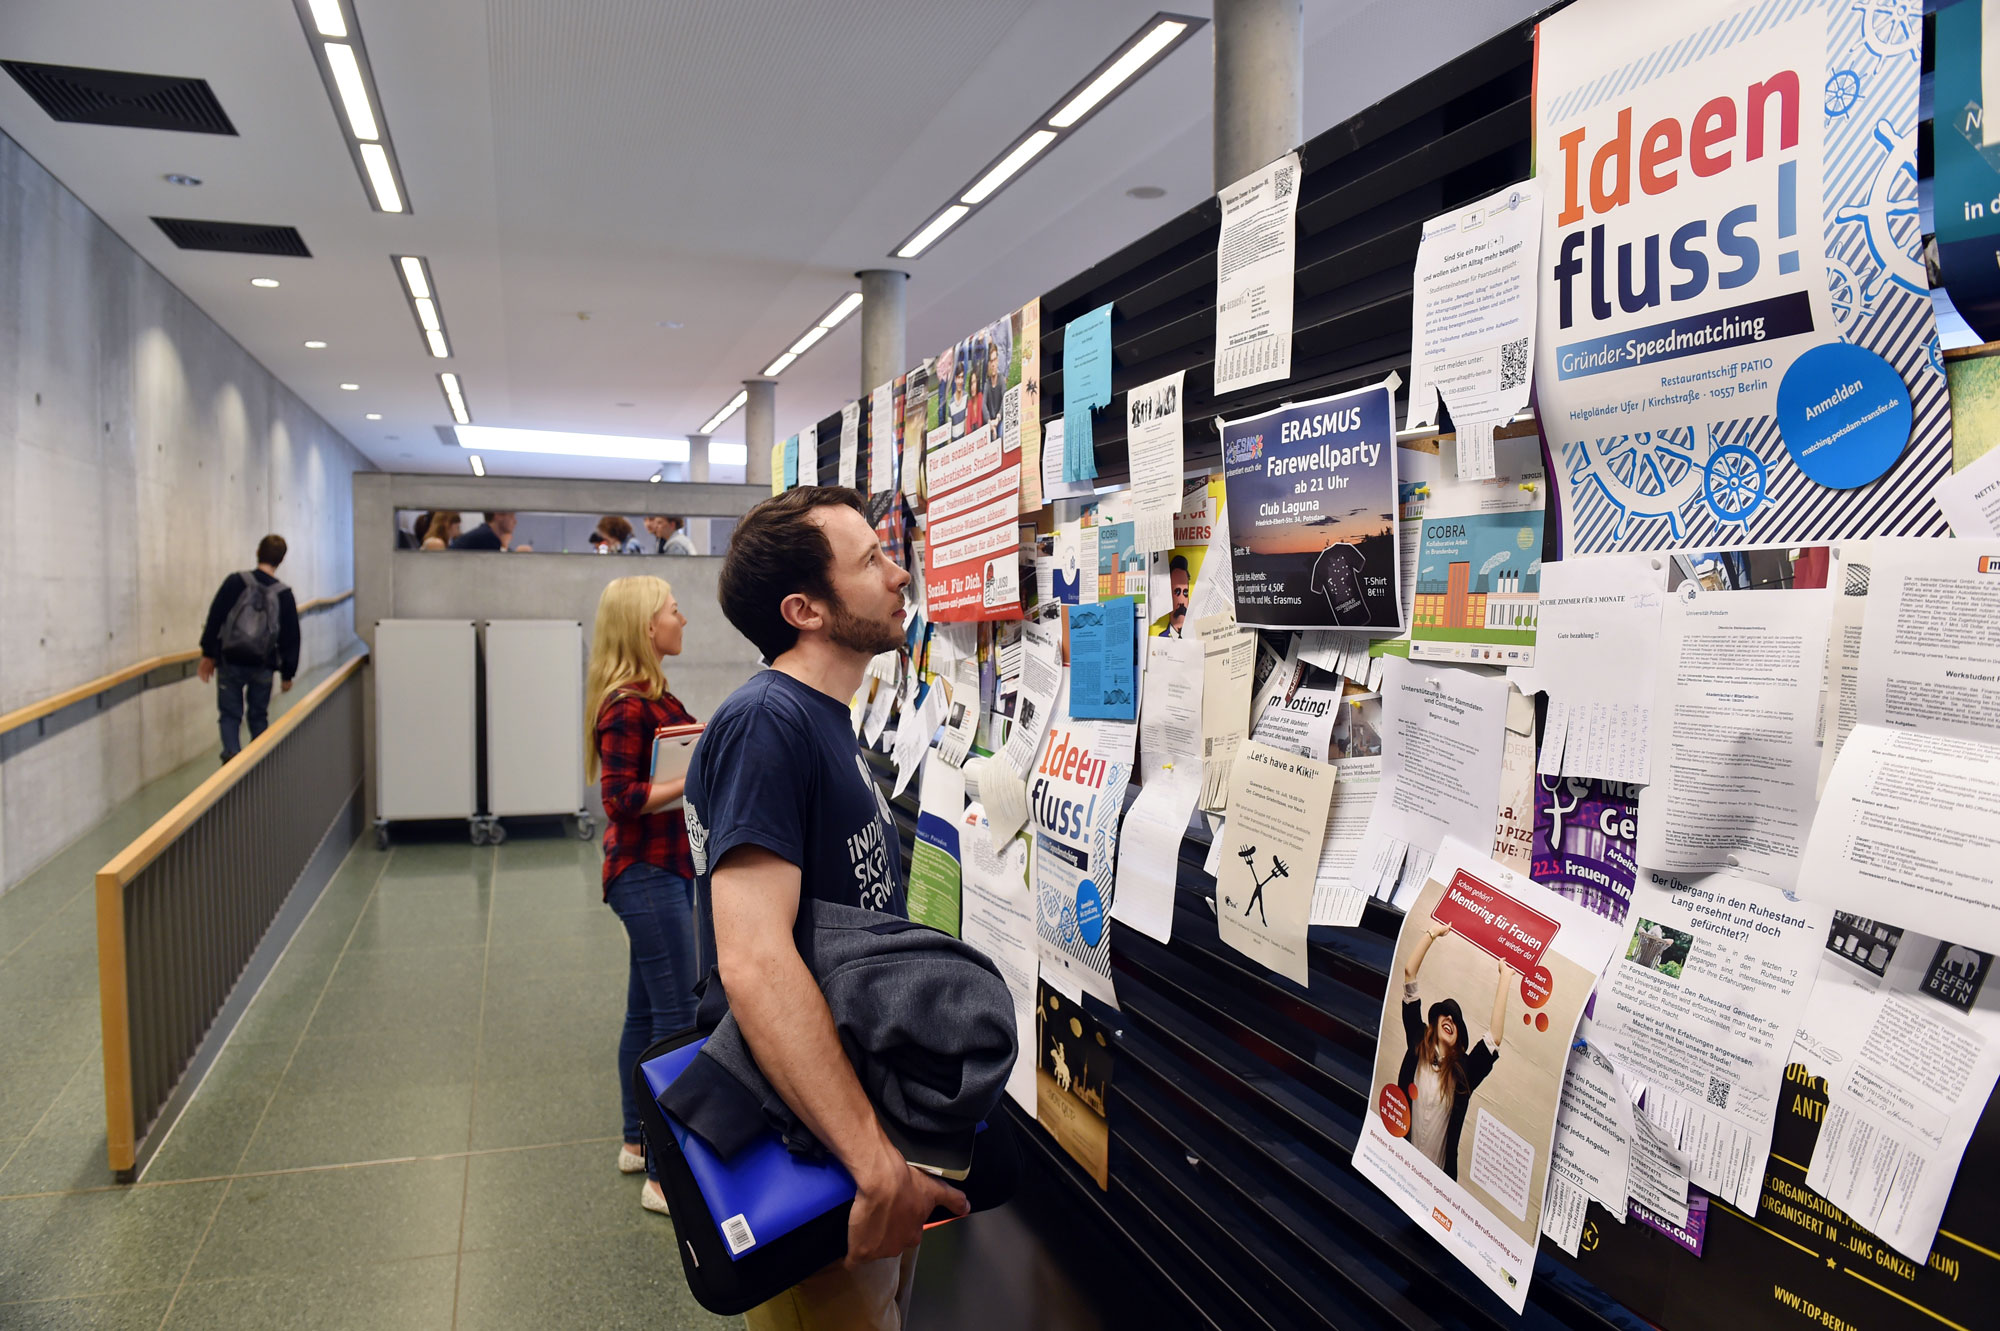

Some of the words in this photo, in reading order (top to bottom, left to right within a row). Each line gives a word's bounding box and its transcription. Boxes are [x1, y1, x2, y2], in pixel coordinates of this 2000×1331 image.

[1558, 69, 1800, 228] Ideen
[1964, 201, 1984, 221] in
[1443, 252, 1456, 263] Sind
[1456, 250, 1464, 259] Sie
[1466, 248, 1474, 256] ein
[1474, 243, 1486, 253] Paar
[1554, 159, 1800, 330] fluss!
[1423, 274, 1432, 282] und
[1432, 268, 1450, 279] wollen
[1450, 265, 1460, 274] sich
[1460, 262, 1468, 270] im
[1468, 257, 1484, 268] Alltag
[1484, 252, 1498, 262] mehr
[1499, 240, 1523, 258] bewegen?
[1561, 315, 1766, 373] Gründer-Speedmatching
[1446, 359, 1468, 370] melden
[1661, 363, 1738, 387] Restaurantschiff
[1740, 357, 1773, 374] PATIO
[1570, 404, 1618, 420] Helgoländer
[1620, 400, 1639, 414] Ufer
[1648, 390, 1700, 408] Kirchstraße
[1709, 386, 1735, 400] 10557
[1738, 379, 1768, 394] Berlin
[1805, 380, 1864, 422] Anmelden
[1281, 406, 1361, 444] ERASMUS
[1802, 398, 1899, 457] matching.potsdam-transfer.de
[1267, 440, 1381, 478] Farewellparty
[1294, 480, 1307, 494] ab
[1310, 478, 1324, 492] 21
[1328, 475, 1350, 490] Uhr
[1974, 483, 1996, 500] NETTE
[1260, 503, 1280, 516] Club
[1282, 500, 1320, 516] Laguna
[1302, 514, 1326, 522] Potsdam
[1427, 524, 1466, 539] COBRA
[928, 580, 949, 599] Sozial.
[951, 578, 964, 594] Für
[965, 572, 982, 591] Dich.
[1268, 584, 1284, 593] 4,50€
[1364, 577, 1387, 586] T-Shirt
[1368, 588, 1385, 597] 8€!!!
[1274, 596, 1302, 605] Erasmus
[1539, 598, 1556, 606] SUCHE
[1557, 596, 1581, 606] ZIMMER
[1582, 595, 1593, 604] FÜR
[1598, 595, 1626, 603] MONATE
[1558, 632, 1569, 640] Gute
[1570, 632, 1594, 641] bezahlung
[1946, 670, 1995, 683] Werkstudent
[1400, 684, 1440, 700] Unterstützung
[1038, 729, 1106, 789] Ideen
[1270, 756, 1288, 771] have
[1288, 764, 1294, 773] a
[1032, 778, 1096, 844] fluss!
[1493, 840, 1518, 857] IVE:
[1534, 859, 1563, 876] 22.5.
[1565, 860, 1610, 888] Frauen
[1456, 879, 1472, 892] Schon
[1471, 887, 1494, 904] gehört?
[1651, 873, 1668, 886] Der
[1670, 876, 1714, 903] Übergang
[1716, 892, 1726, 904] in
[1728, 897, 1746, 910] den
[1749, 903, 1806, 930] Ruhestand
[1448, 888, 1496, 925] Mentoring
[1493, 914, 1510, 931] für
[1508, 923, 1542, 951] Frauen
[1671, 895, 1694, 912] Lang
[1695, 902, 1732, 922] ersehnt
[1734, 914, 1753, 928] und
[1754, 920, 1782, 938] doch
[1690, 916, 1750, 943] gefürchtet?!
[1498, 935, 1506, 945] ist
[1505, 940, 1523, 955] wieder
[1534, 972, 1547, 984] Start
[1628, 966, 1680, 990] Forschungsprojekt
[1760, 968, 1795, 987] Ruhestand
[1761, 959, 1783, 974] letzten
[1789, 968, 1798, 978] 12
[1524, 976, 1549, 997] September
[1718, 973, 1756, 993] Erfahrungen!
[1738, 972, 1777, 992] interessieren
[1930, 980, 1969, 1004] BEIN
[1934, 968, 1974, 994] ELFEN
[1527, 989, 1539, 1001] 2014
[1616, 1002, 1632, 1014] Dafür
[1632, 1009, 1645, 1020] sind
[1664, 1022, 1676, 1033] Ihre
[1677, 1028, 1715, 1050] Erfahrungen
[1715, 1042, 1754, 1068] angewiesen.
[1632, 1018, 1654, 1034] Machen
[1654, 1028, 1664, 1038] Sie
[1665, 1032, 1675, 1042] mit
[1686, 1042, 1709, 1058] unserer
[1709, 1051, 1732, 1067] Studie!
[1574, 1084, 1596, 1102] schönes
[1596, 1096, 1607, 1108] und
[1576, 1074, 1585, 1084] Uni
[1585, 1078, 1609, 1097] Potsdam
[1582, 1099, 1604, 1118] Potsdam
[1604, 1112, 1617, 1127] oder
[1586, 1136, 1610, 1157] Angebot
[1762, 1193, 1824, 1236] ORGANISIERT
[1826, 1224, 1838, 1243] IN
[1876, 1249, 1916, 1282] GANZE!
